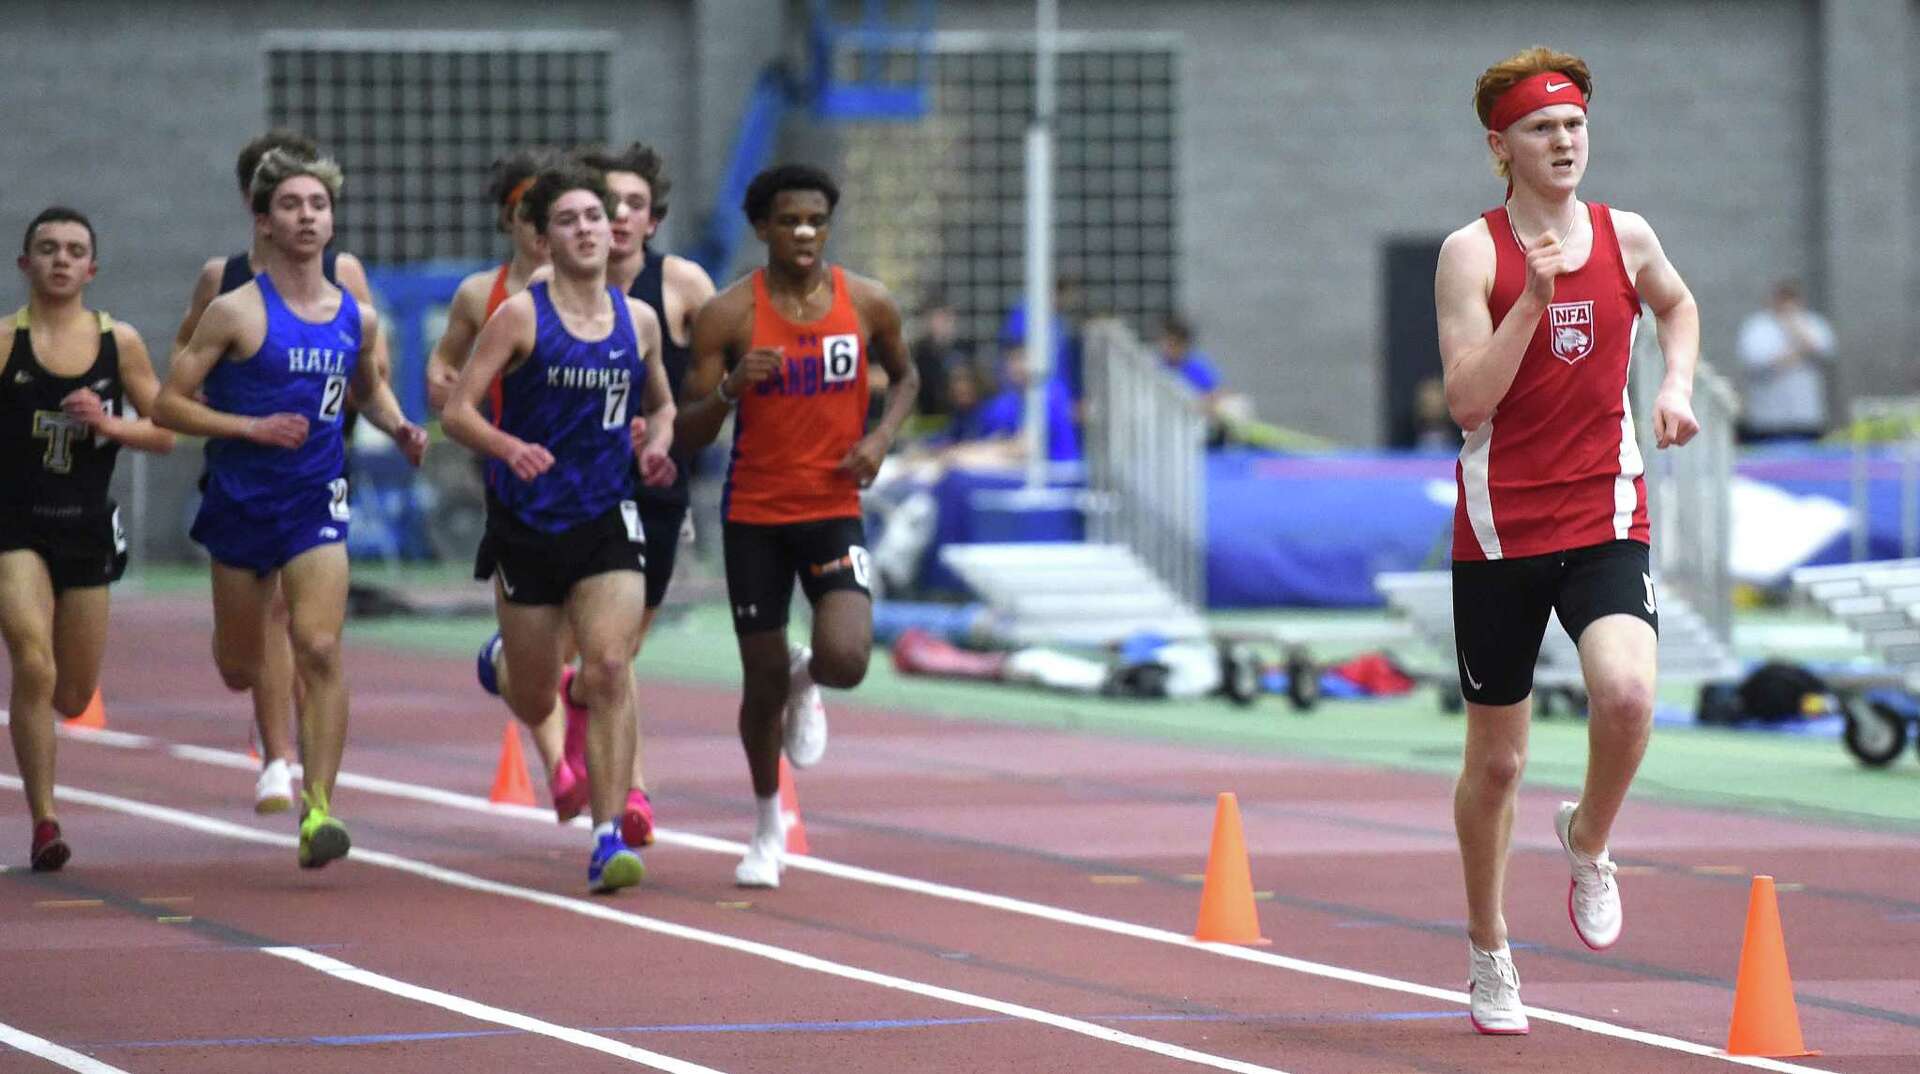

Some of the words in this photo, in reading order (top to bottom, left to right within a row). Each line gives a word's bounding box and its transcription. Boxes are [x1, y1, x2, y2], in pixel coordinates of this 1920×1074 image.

[1555, 308, 1588, 323] NFA
[288, 347, 345, 374] HALL
[830, 340, 852, 377] 6
[324, 381, 343, 416] 2
[609, 388, 626, 424] 7
[32, 410, 89, 475] T
